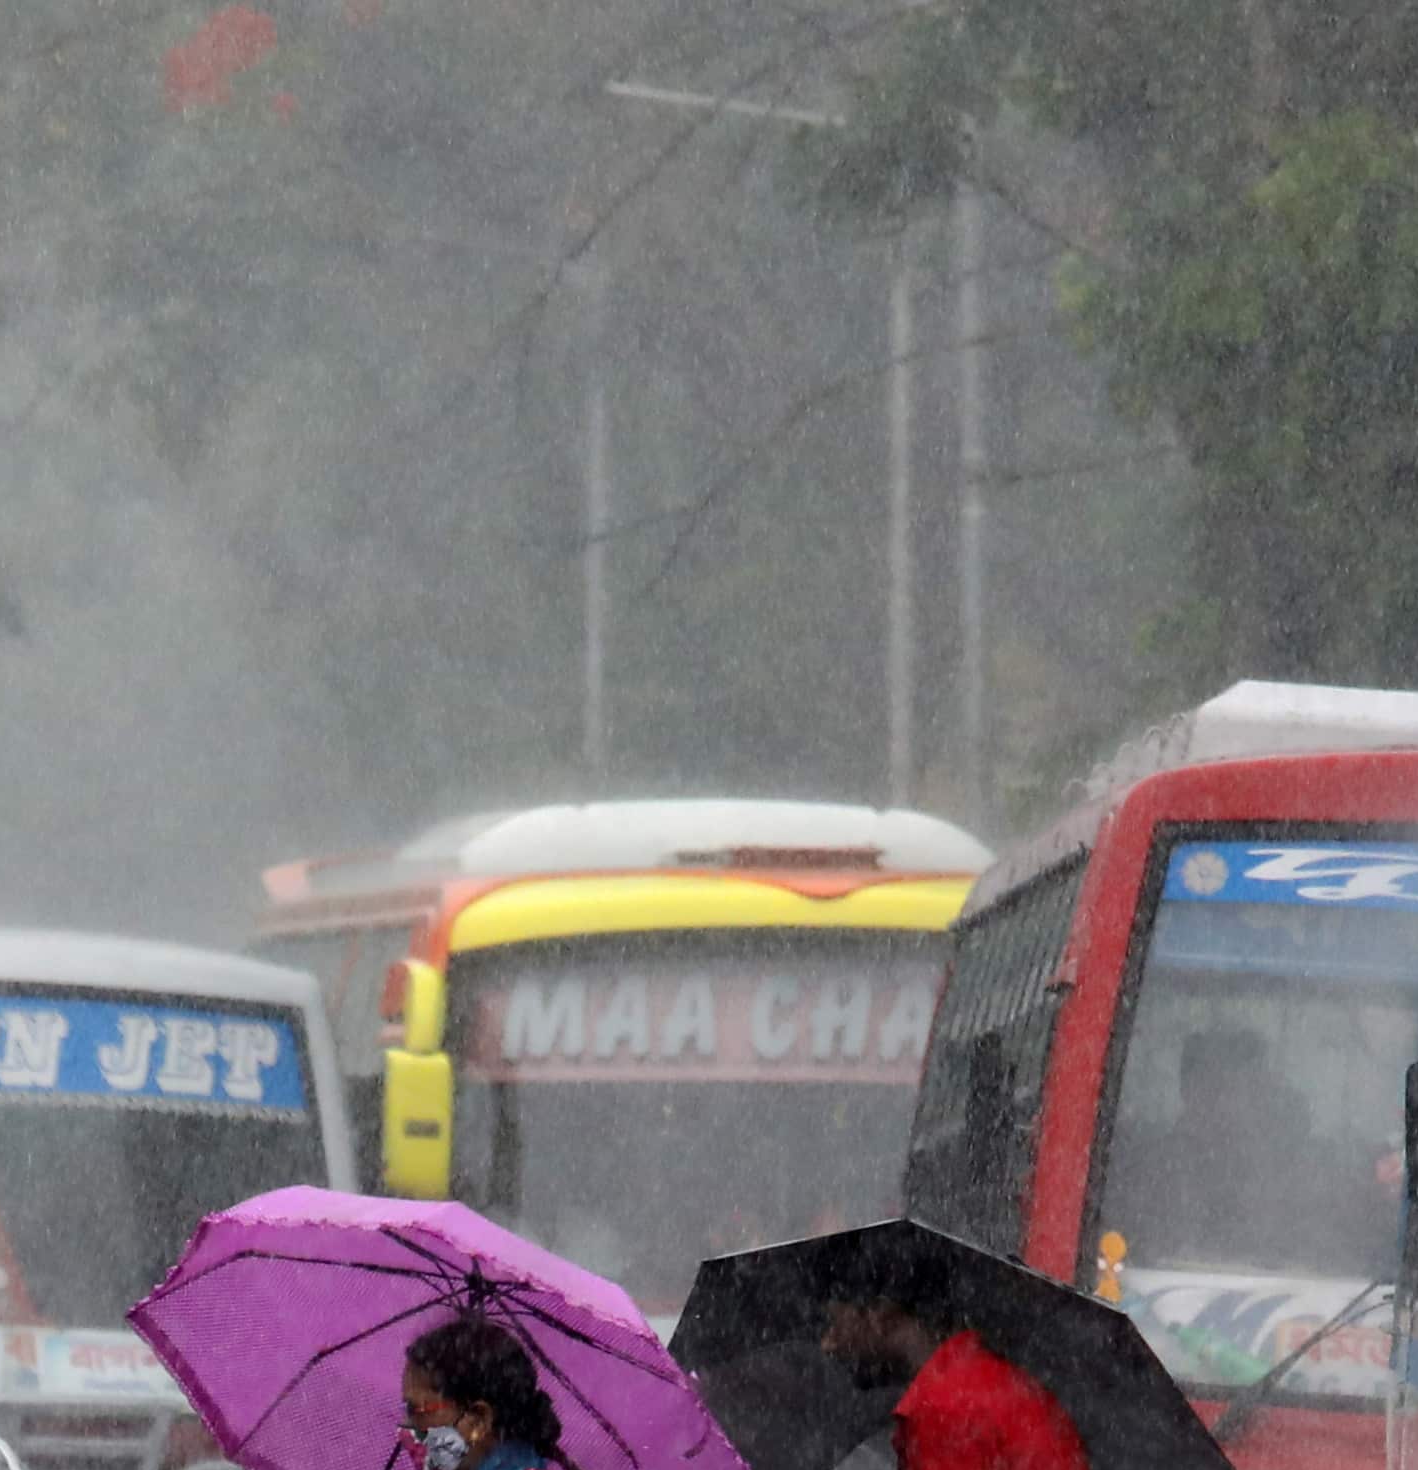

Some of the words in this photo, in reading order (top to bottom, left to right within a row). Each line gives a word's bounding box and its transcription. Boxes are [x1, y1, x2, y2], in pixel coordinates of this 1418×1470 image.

[98, 1014, 278, 1098] JET
[501, 976, 717, 1060] MAA
[751, 976, 935, 1060] CHA
